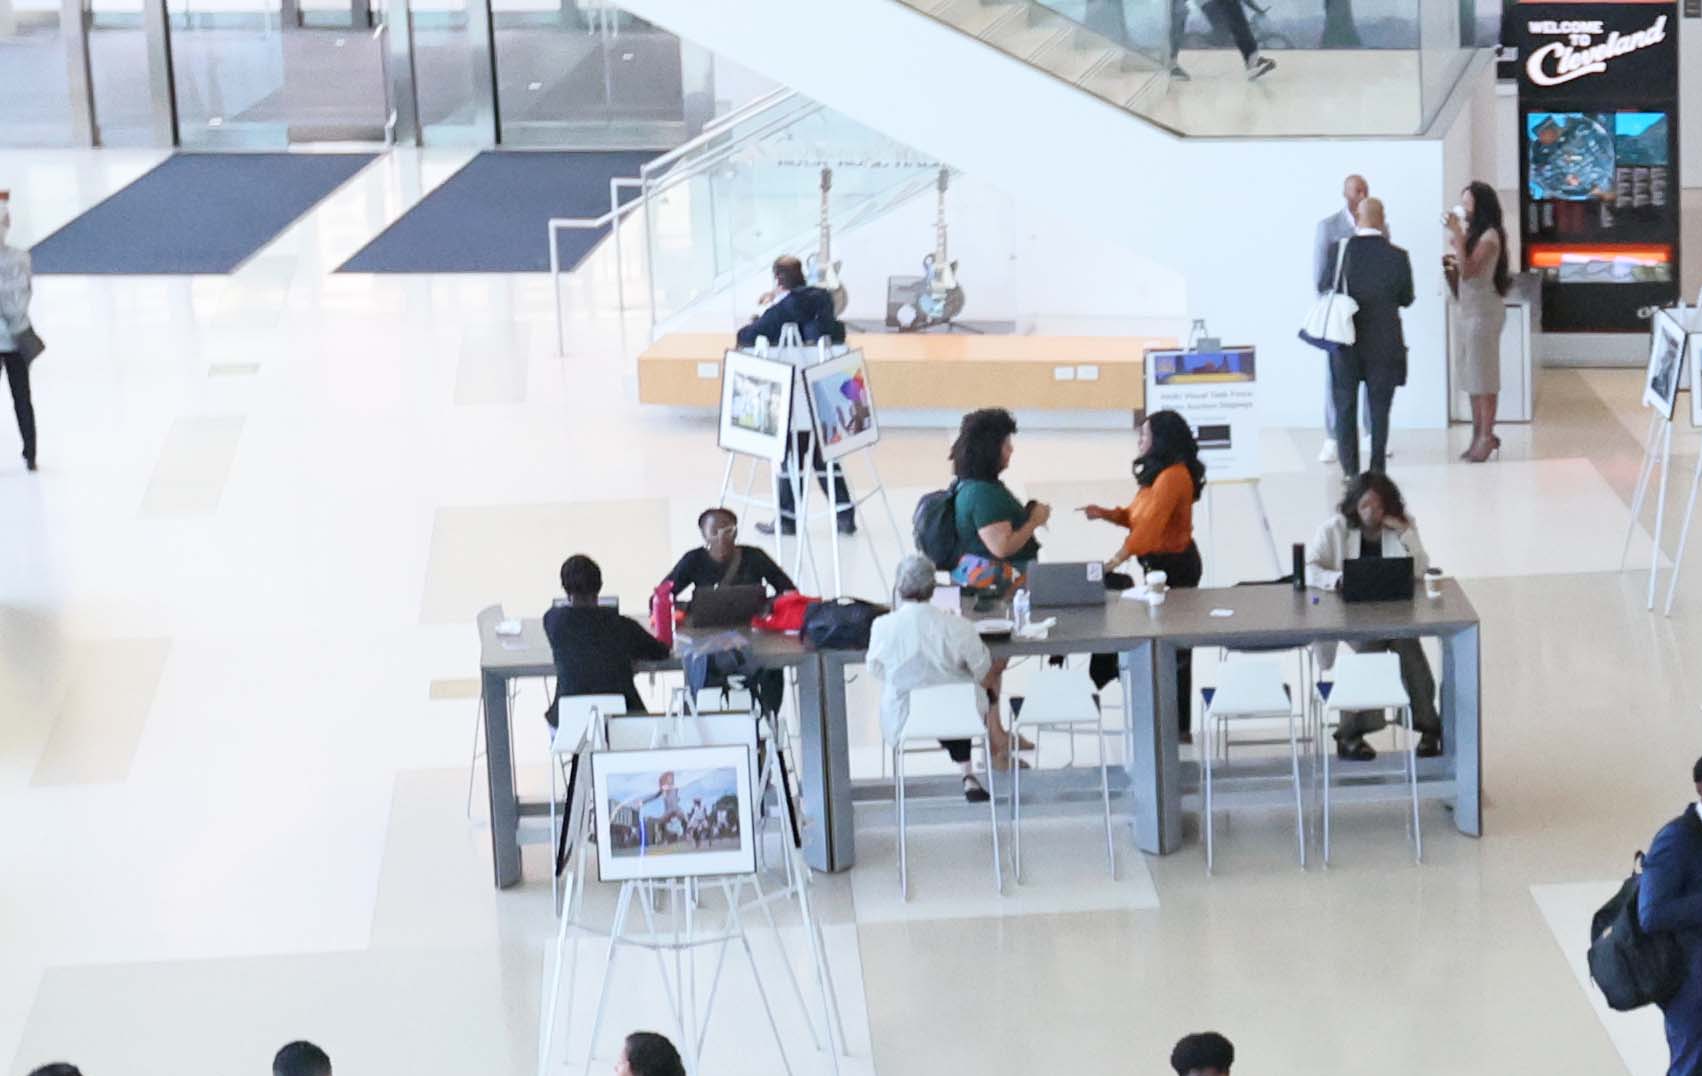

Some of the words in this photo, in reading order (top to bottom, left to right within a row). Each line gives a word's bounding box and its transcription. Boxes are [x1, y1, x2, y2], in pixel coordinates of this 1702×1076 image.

[1528, 20, 1604, 34] WELCOME
[1568, 33, 1592, 46] TO
[1526, 15, 1668, 87] Cleveland
